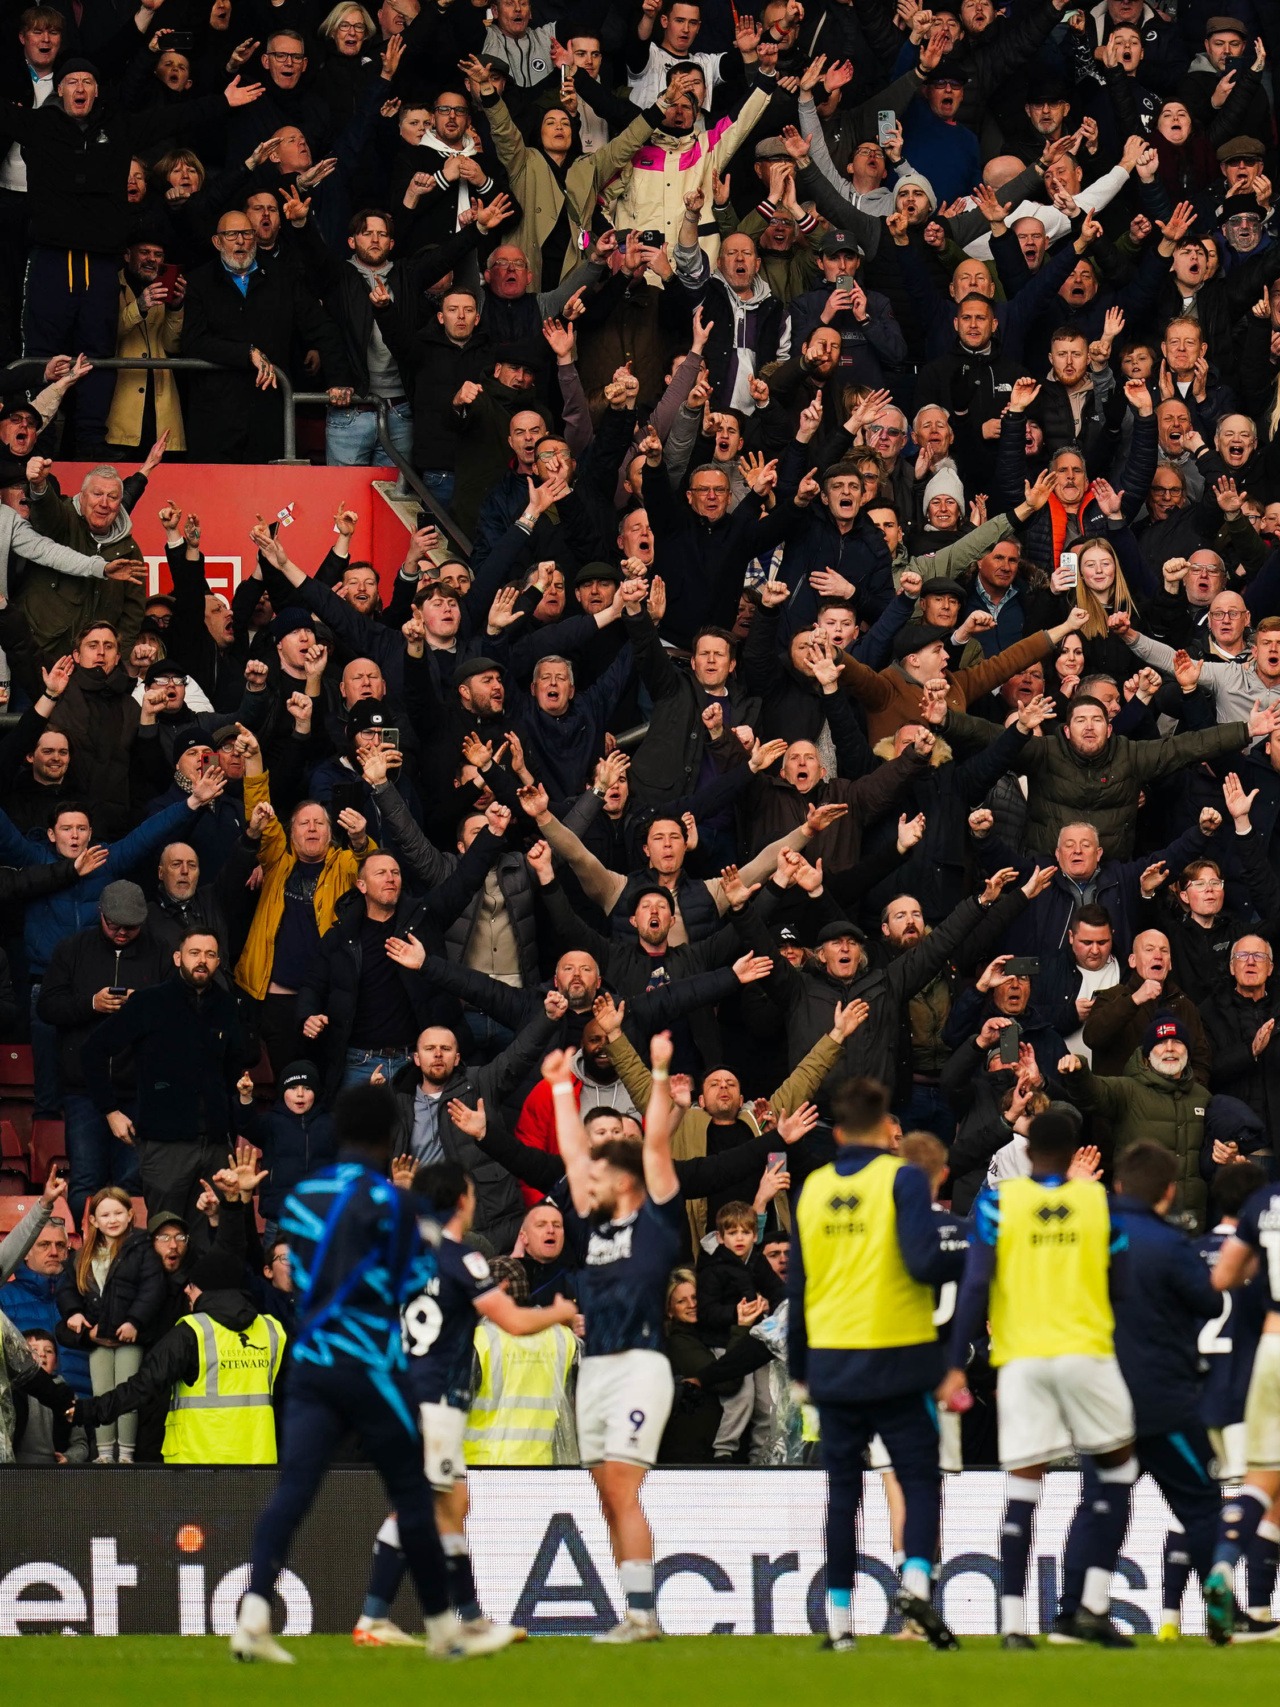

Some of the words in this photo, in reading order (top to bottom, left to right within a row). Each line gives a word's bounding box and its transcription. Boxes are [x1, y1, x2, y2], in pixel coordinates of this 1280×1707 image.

[401, 1295, 444, 1357] 9
[1198, 1290, 1233, 1354] 2
[220, 1359, 270, 1370] STEWARD
[630, 1410, 645, 1432] 9
[511, 1511, 1153, 1636] Acronis
